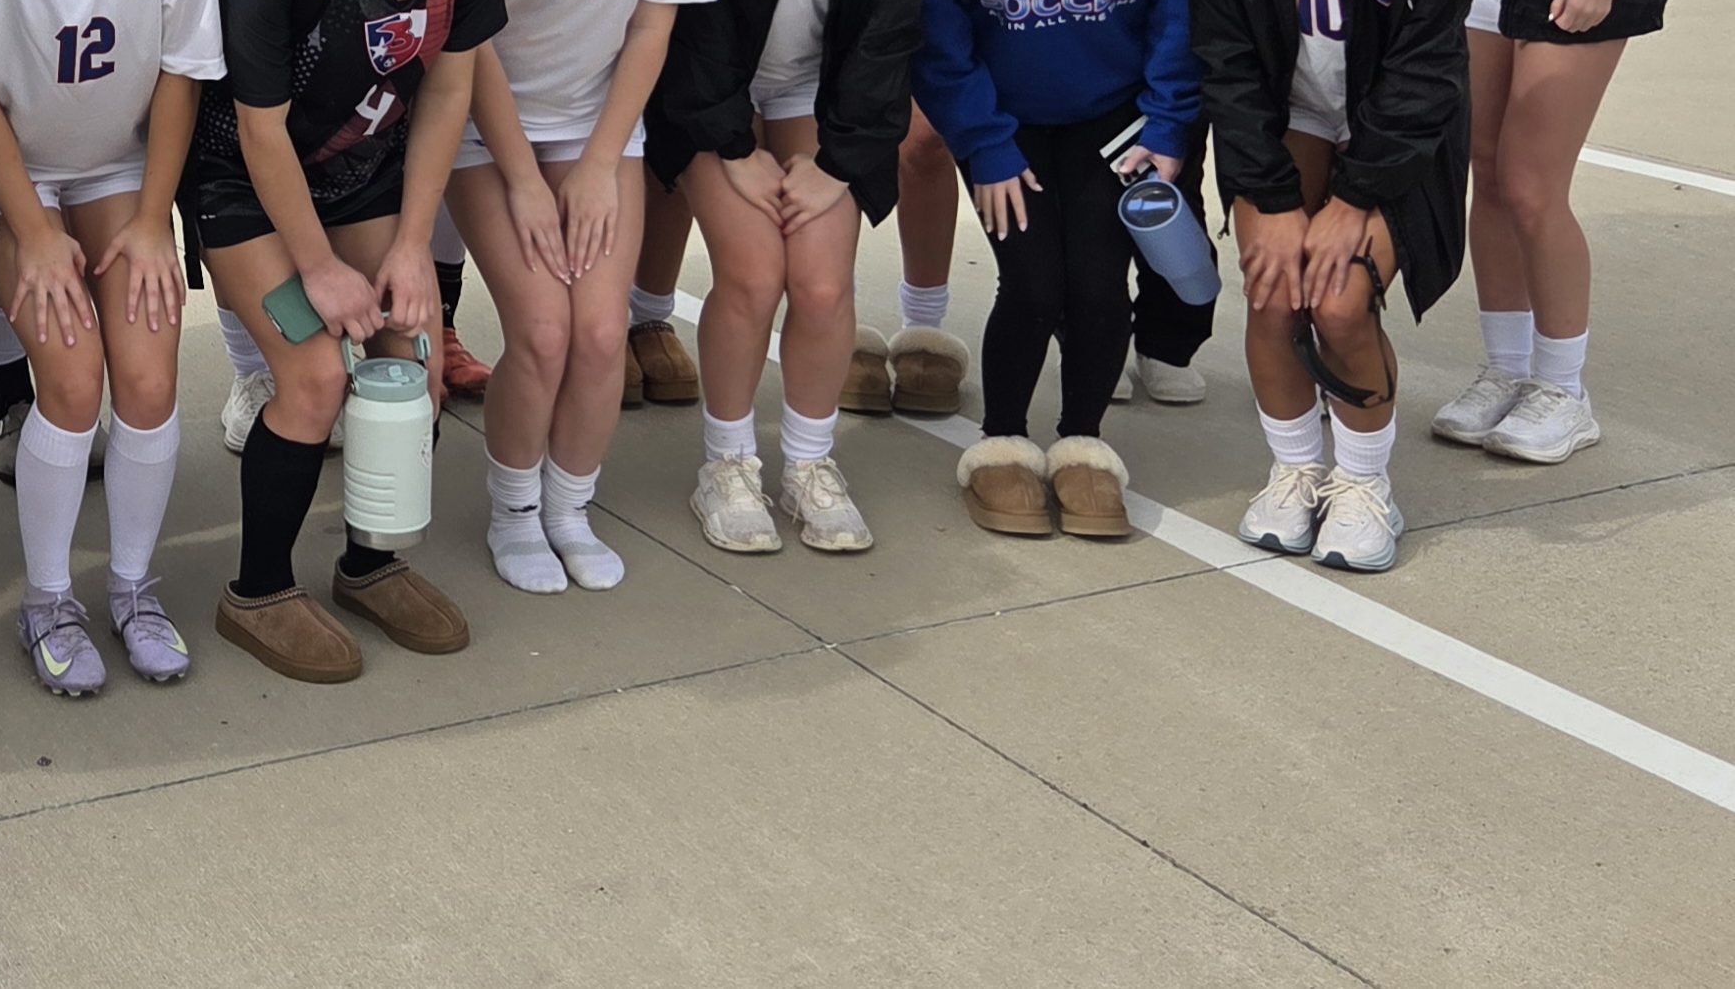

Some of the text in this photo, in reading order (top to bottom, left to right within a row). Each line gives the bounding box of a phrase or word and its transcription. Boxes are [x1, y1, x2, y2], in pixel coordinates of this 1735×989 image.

[1008, 22, 1025, 31] IN
[1034, 16, 1067, 28] ALL
[1073, 13, 1107, 22] THE
[55, 16, 116, 84] 12
[354, 83, 396, 136] 4
